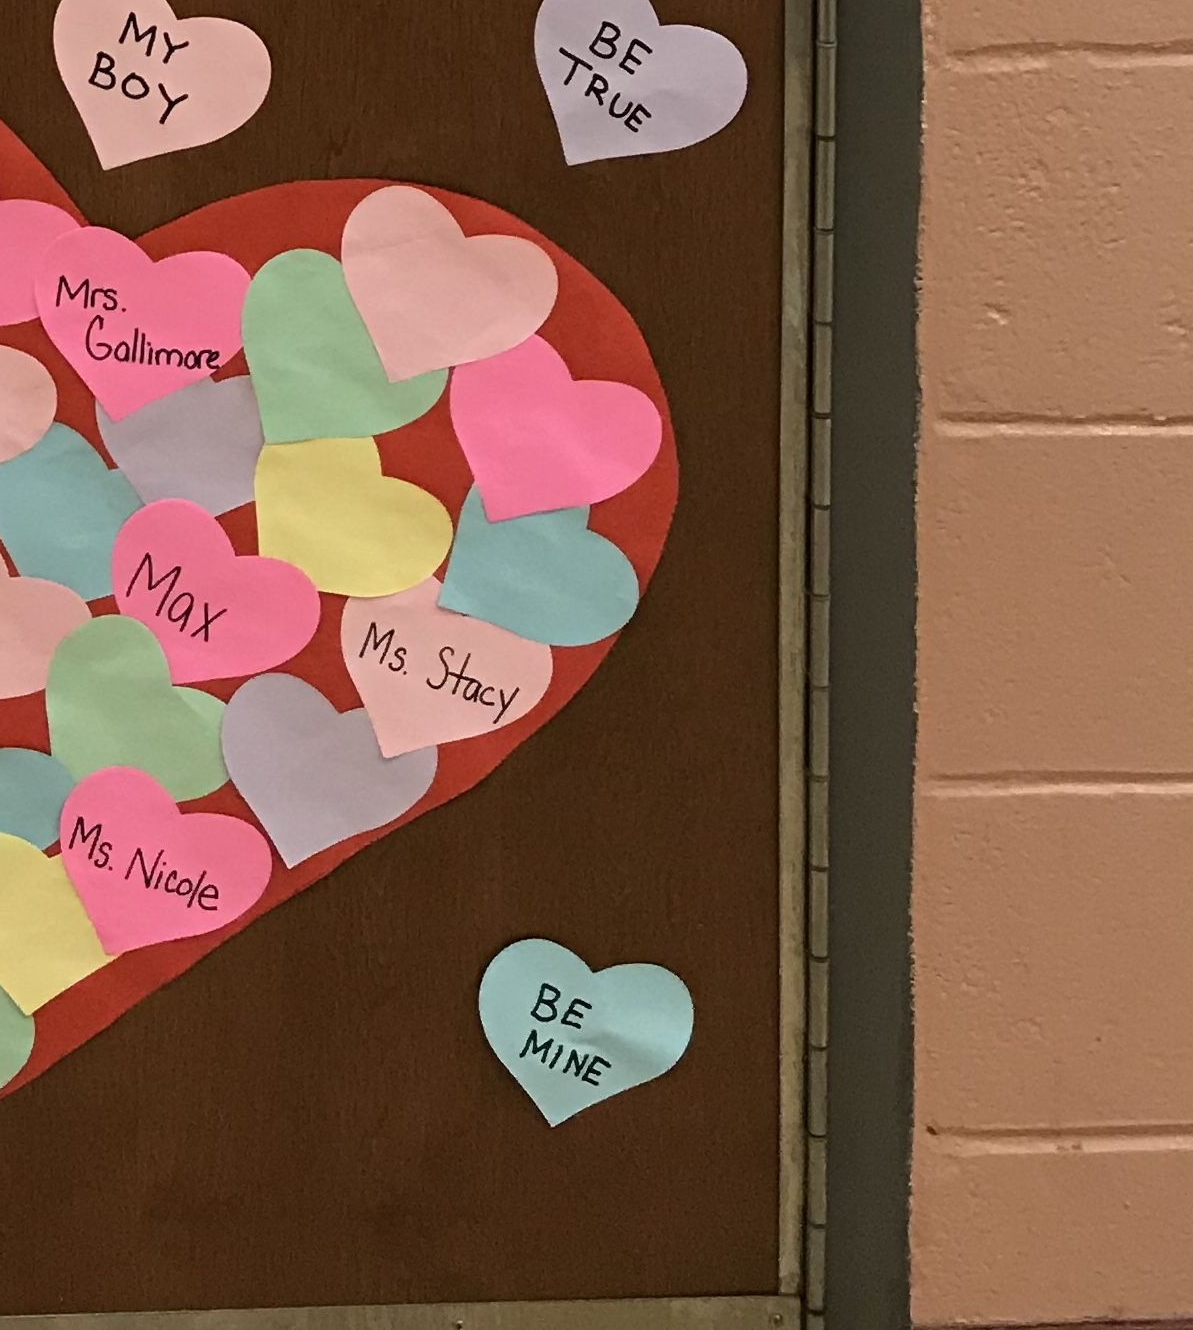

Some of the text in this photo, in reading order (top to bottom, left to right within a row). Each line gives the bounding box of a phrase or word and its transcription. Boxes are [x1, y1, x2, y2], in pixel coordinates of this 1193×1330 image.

[118, 11, 190, 65] MY
[588, 20, 653, 76] BE
[87, 50, 189, 125] BOY
[558, 46, 652, 133] TRUE
[55, 274, 127, 313] Mrs.
[84, 315, 222, 372] Gallimore
[125, 552, 228, 643] Max
[357, 620, 520, 725] Ms. Stacy
[66, 815, 219, 911] Ms. Nicole
[530, 982, 593, 1030] BE
[518, 1028, 612, 1087] MINE
